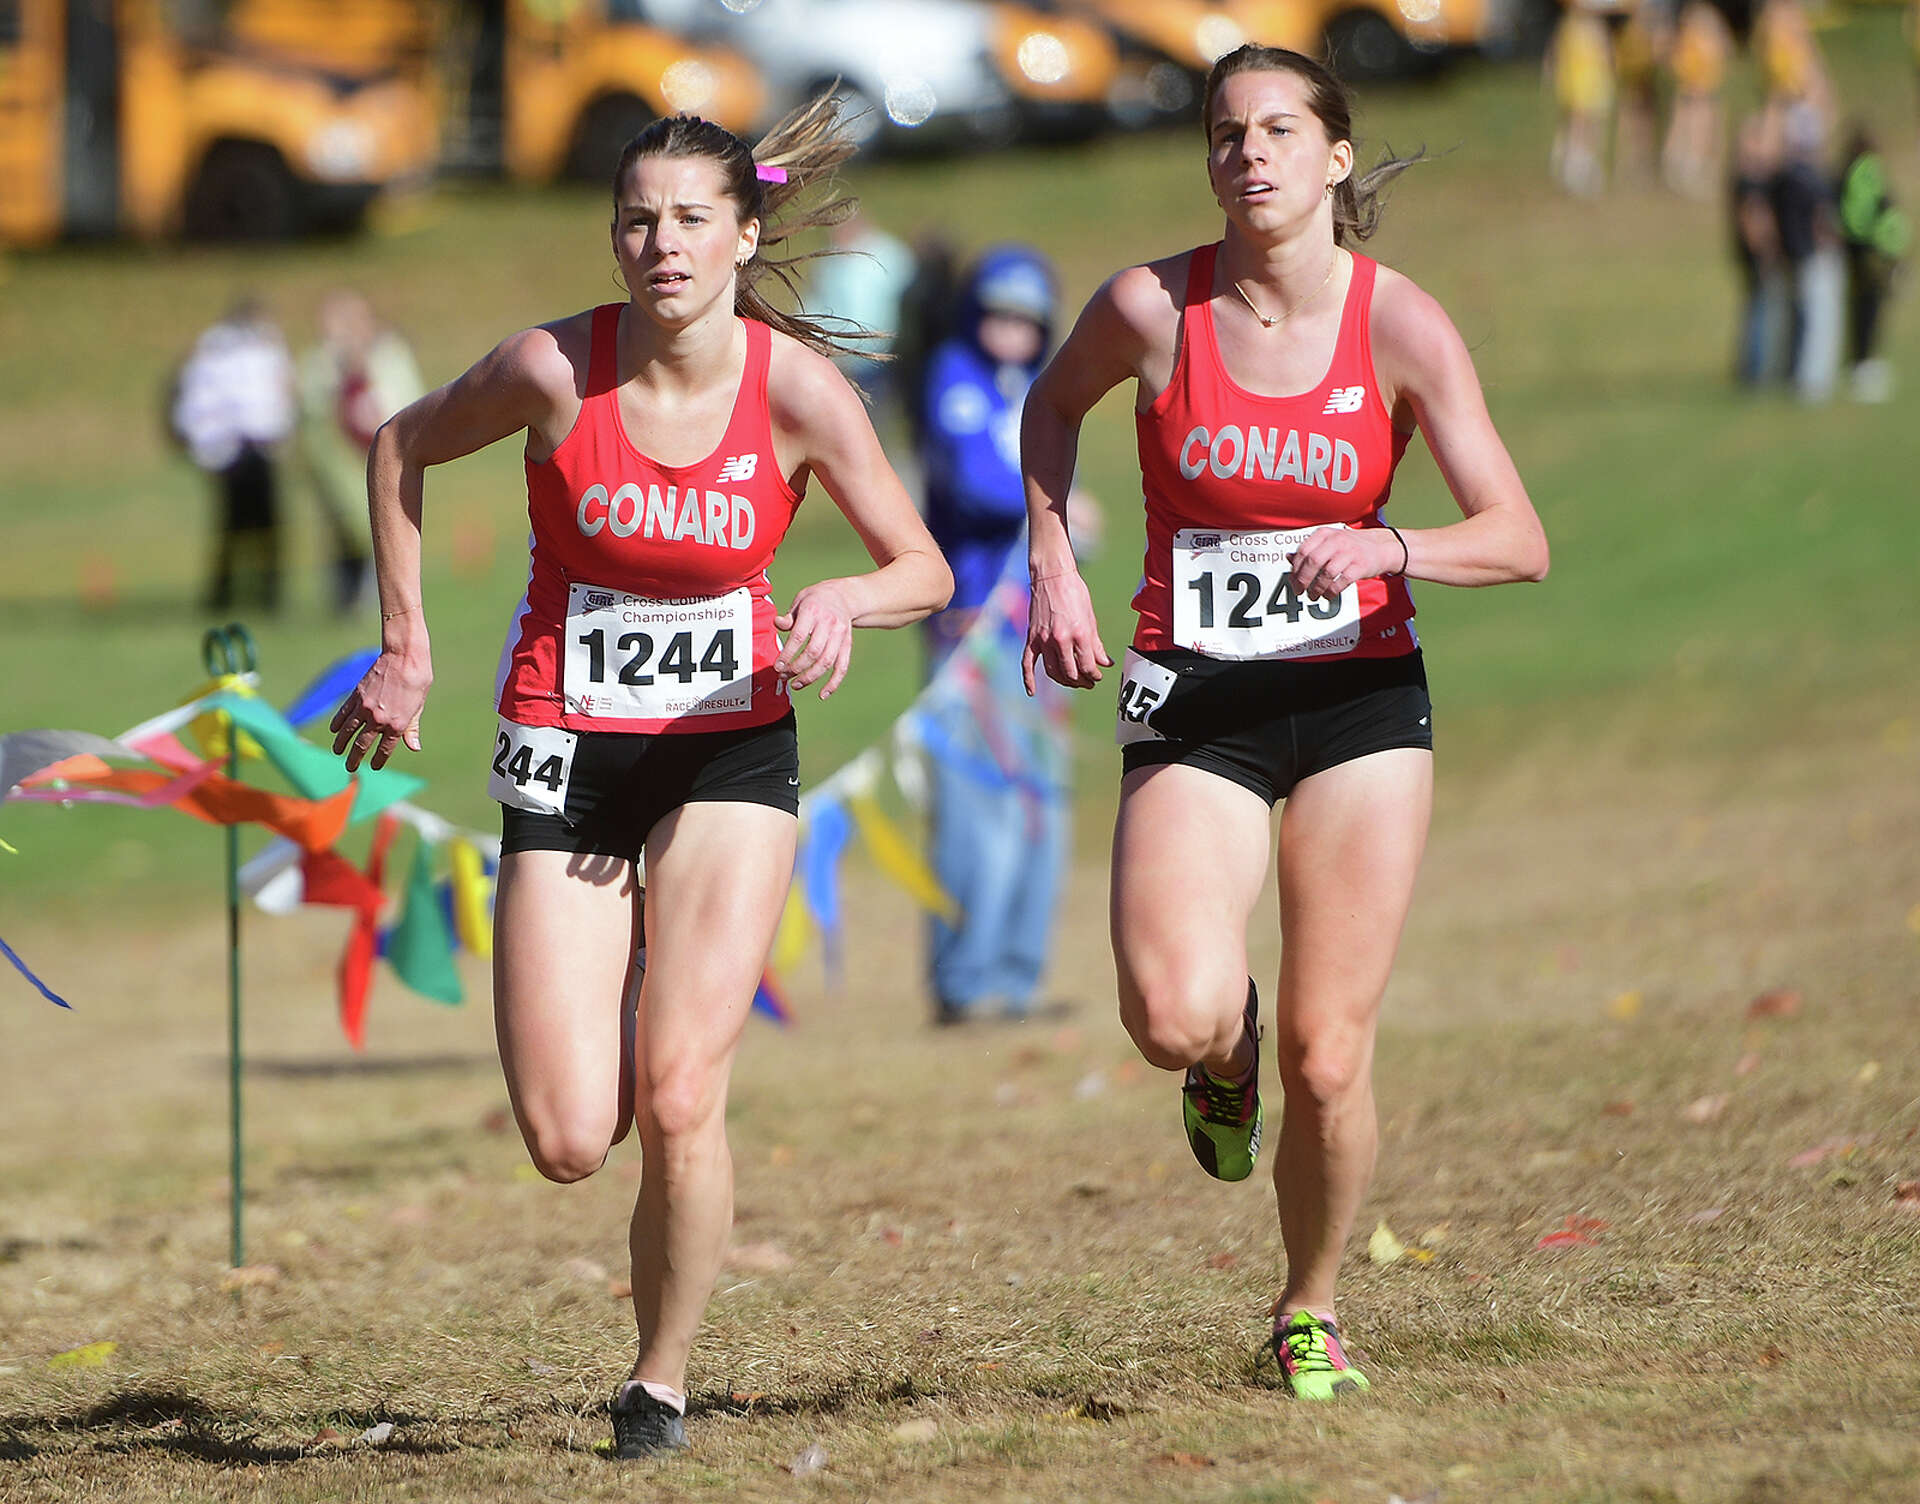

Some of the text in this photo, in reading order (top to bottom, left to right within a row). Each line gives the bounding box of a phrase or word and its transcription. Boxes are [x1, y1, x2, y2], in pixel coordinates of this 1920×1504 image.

[1179, 424, 1359, 494] CONARD
[577, 482, 756, 550] CONARD
[1229, 533, 1269, 546] Cross
[623, 594, 664, 607] Cross
[622, 608, 735, 624] Championships
[1314, 636, 1348, 649] RESULT
[579, 628, 739, 686] 1244
[665, 698, 740, 712] RACE RESULT
